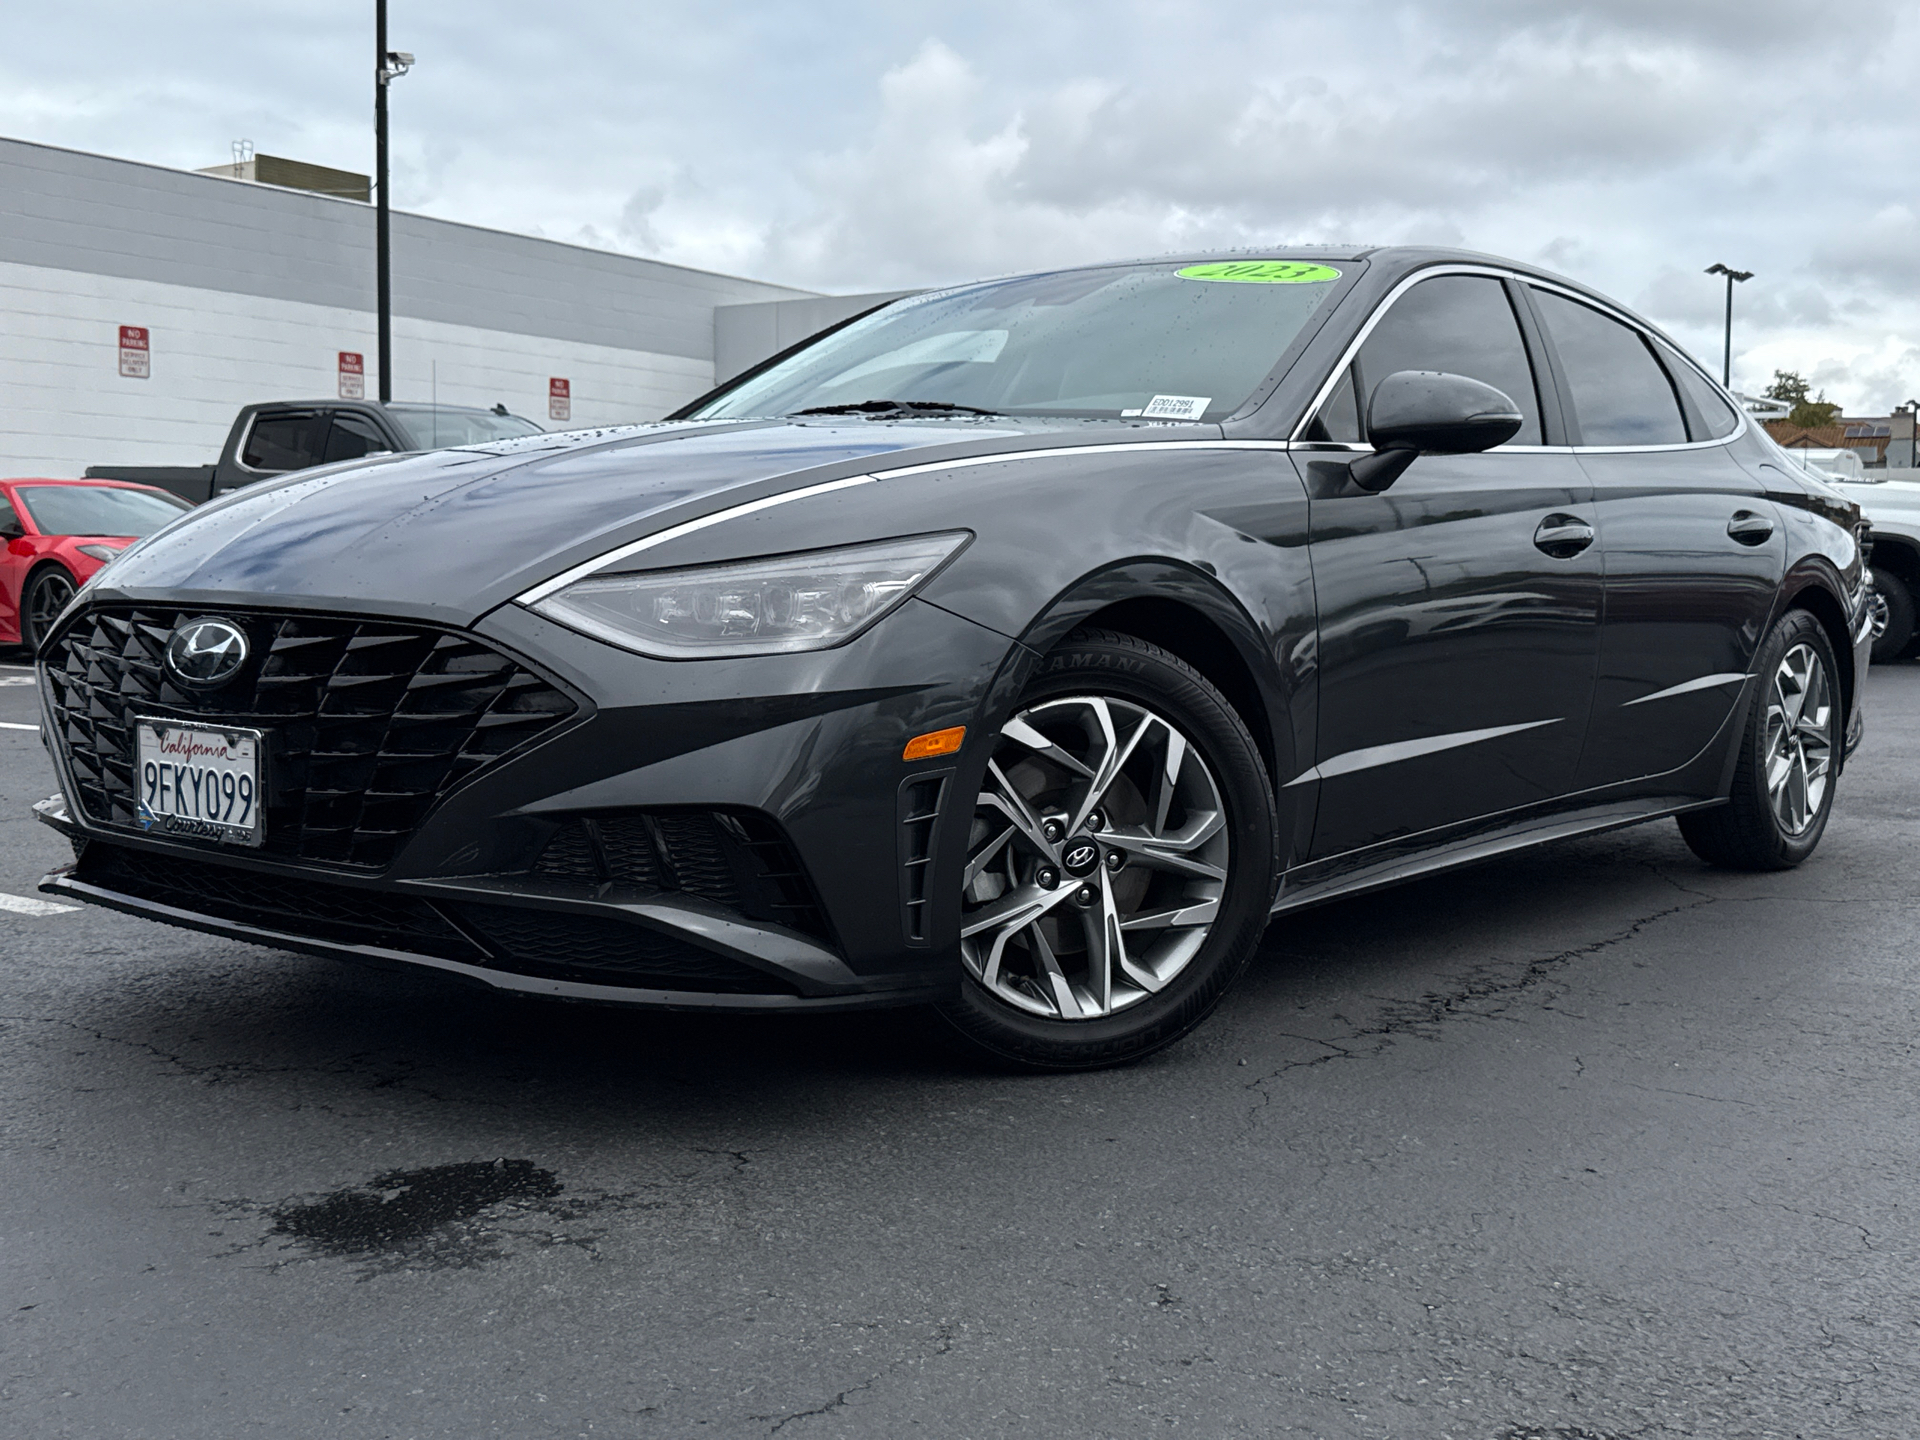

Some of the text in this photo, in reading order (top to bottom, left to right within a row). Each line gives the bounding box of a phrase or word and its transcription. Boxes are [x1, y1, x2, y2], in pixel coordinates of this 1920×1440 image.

[1193, 264, 1319, 279] 2023
[127, 329, 141, 339] NO
[122, 337, 147, 348] PARKING
[123, 351, 146, 360] SERVICE
[346, 355, 357, 364] NO
[122, 359, 148, 367] DELIVERY
[341, 362, 362, 373] PARKING
[551, 387, 568, 396] PARKING
[160, 729, 237, 764] California
[144, 760, 253, 824] 9FKY099
[165, 813, 224, 841] Courtesy
